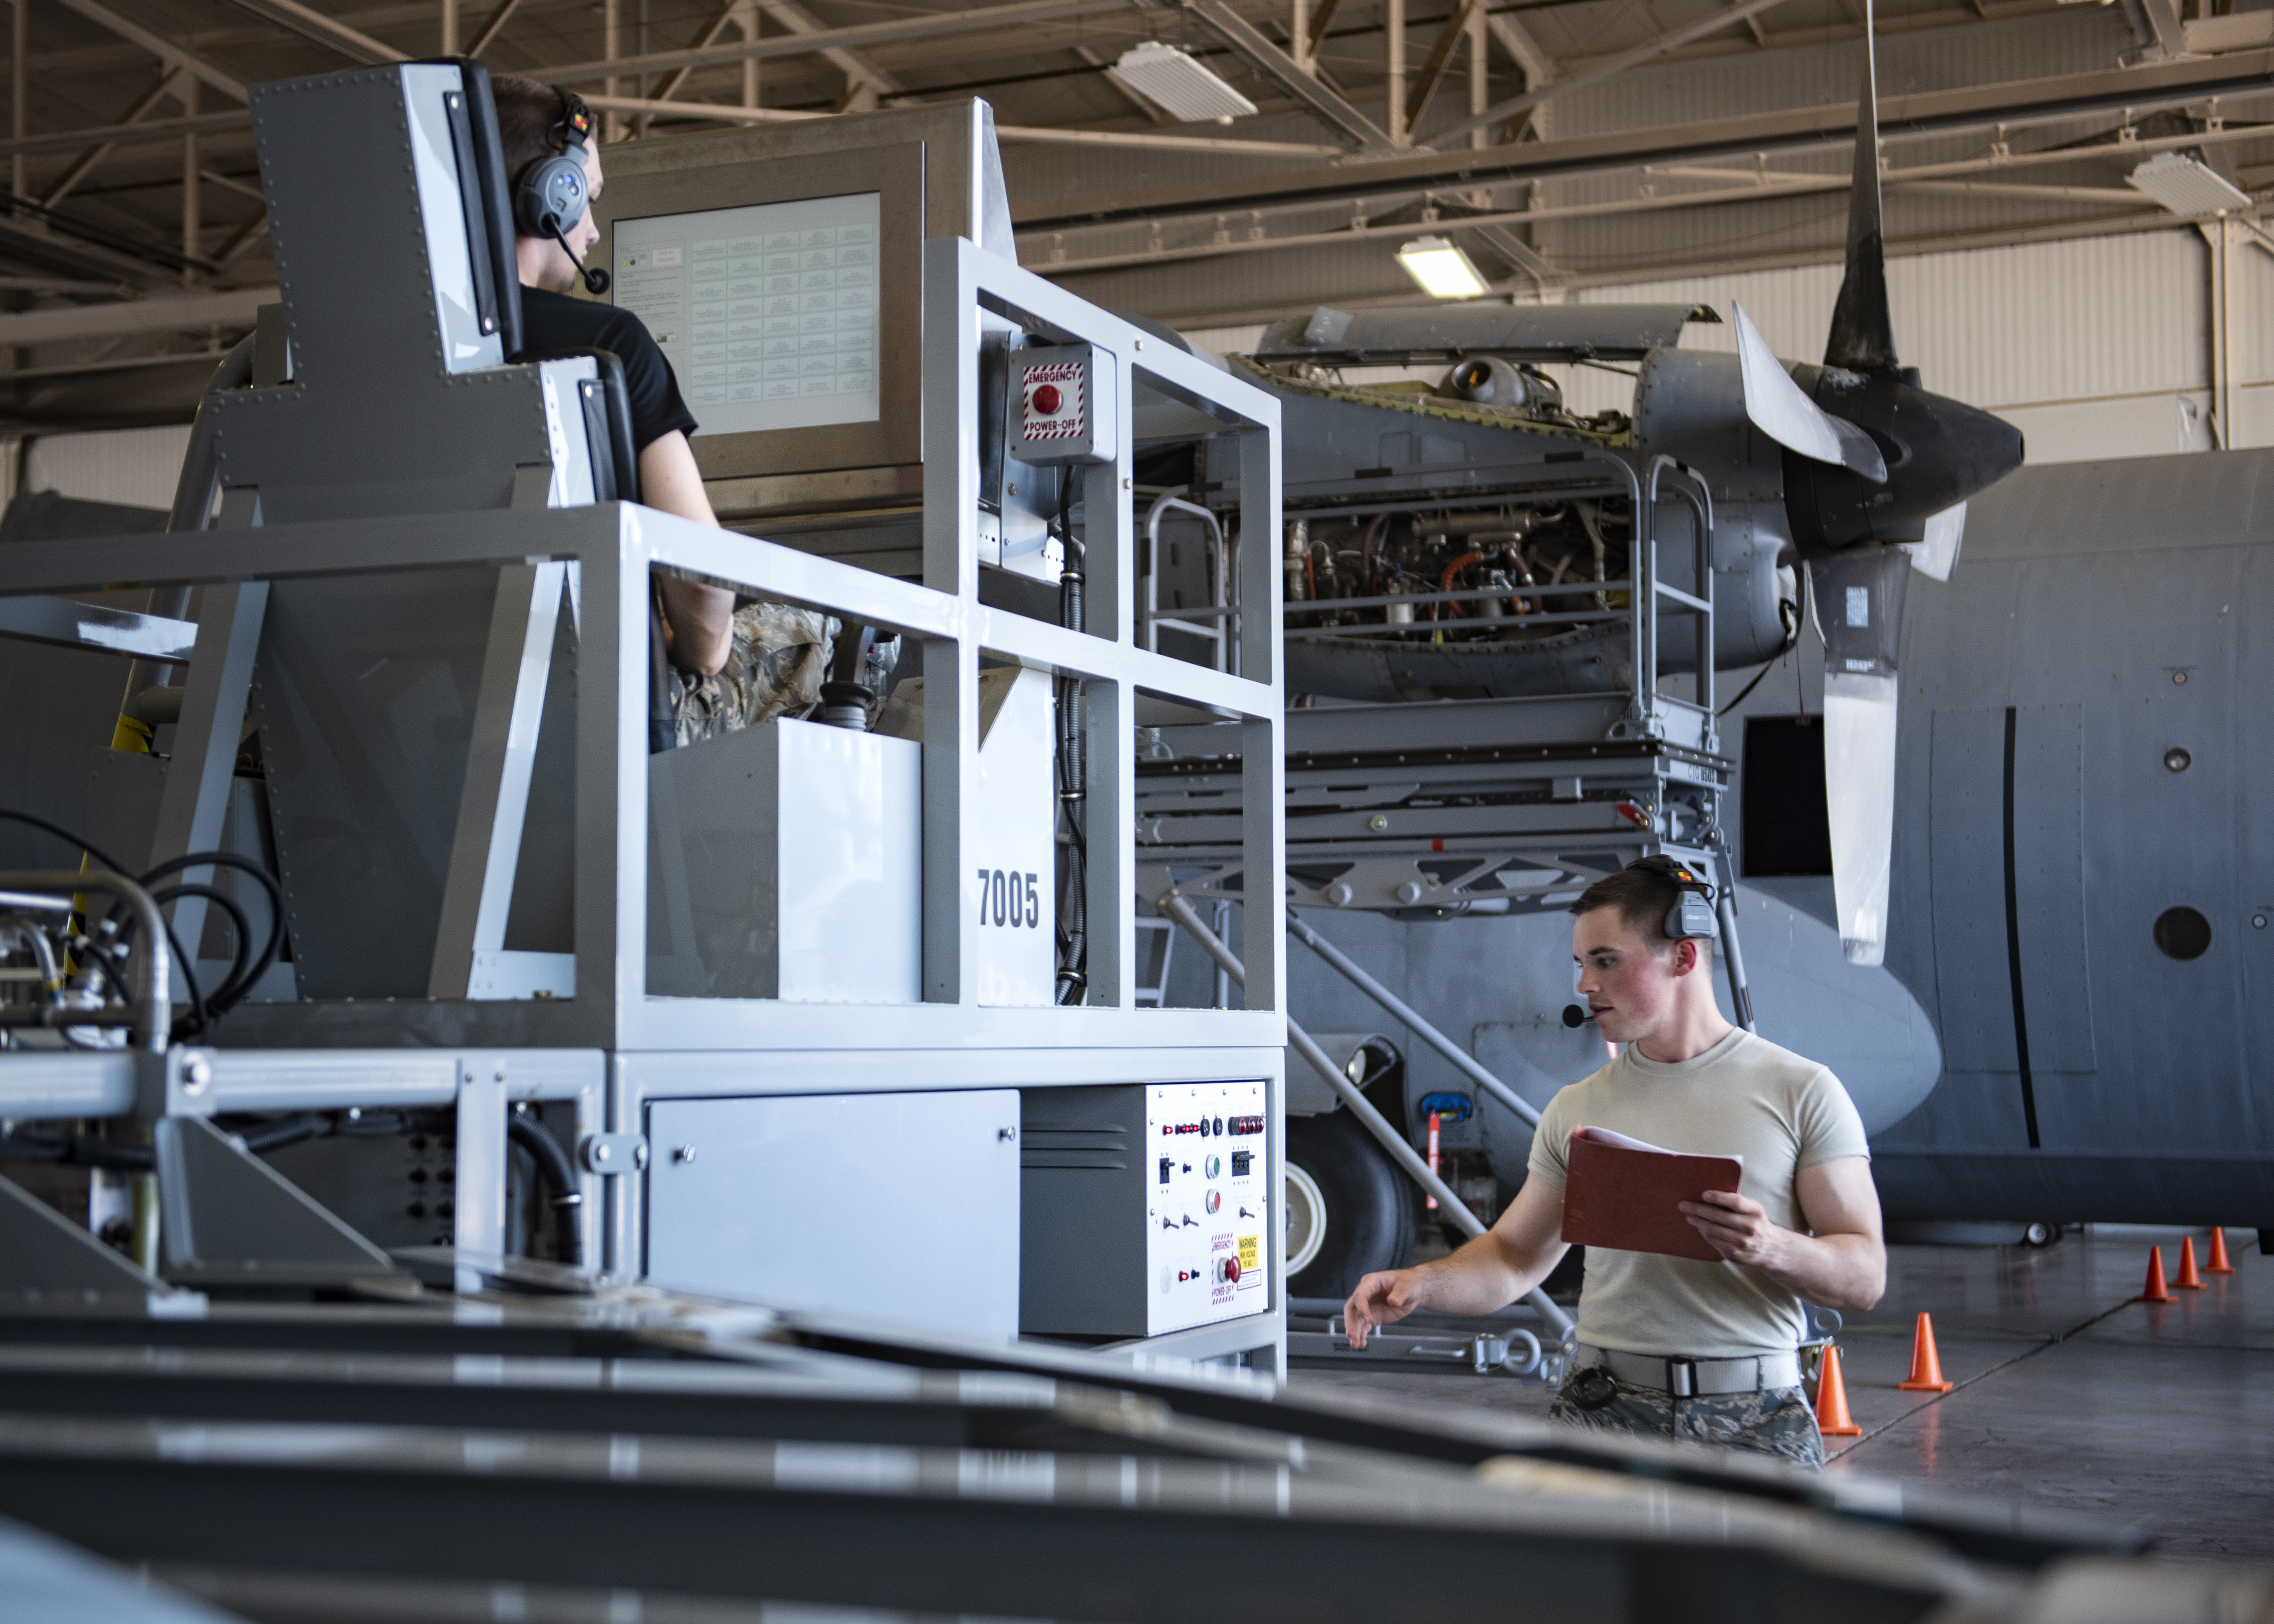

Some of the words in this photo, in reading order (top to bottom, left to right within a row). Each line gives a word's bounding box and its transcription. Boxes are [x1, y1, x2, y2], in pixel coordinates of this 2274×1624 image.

[1028, 370, 1077, 383] EMERGENCY
[1030, 419, 1076, 431] POWER-OFF
[978, 868, 1038, 929] 7005
[1213, 1240, 1231, 1250] EMERGENCY
[1239, 1237, 1256, 1249] WARNING
[1214, 1286, 1231, 1296] POWER-OFF
